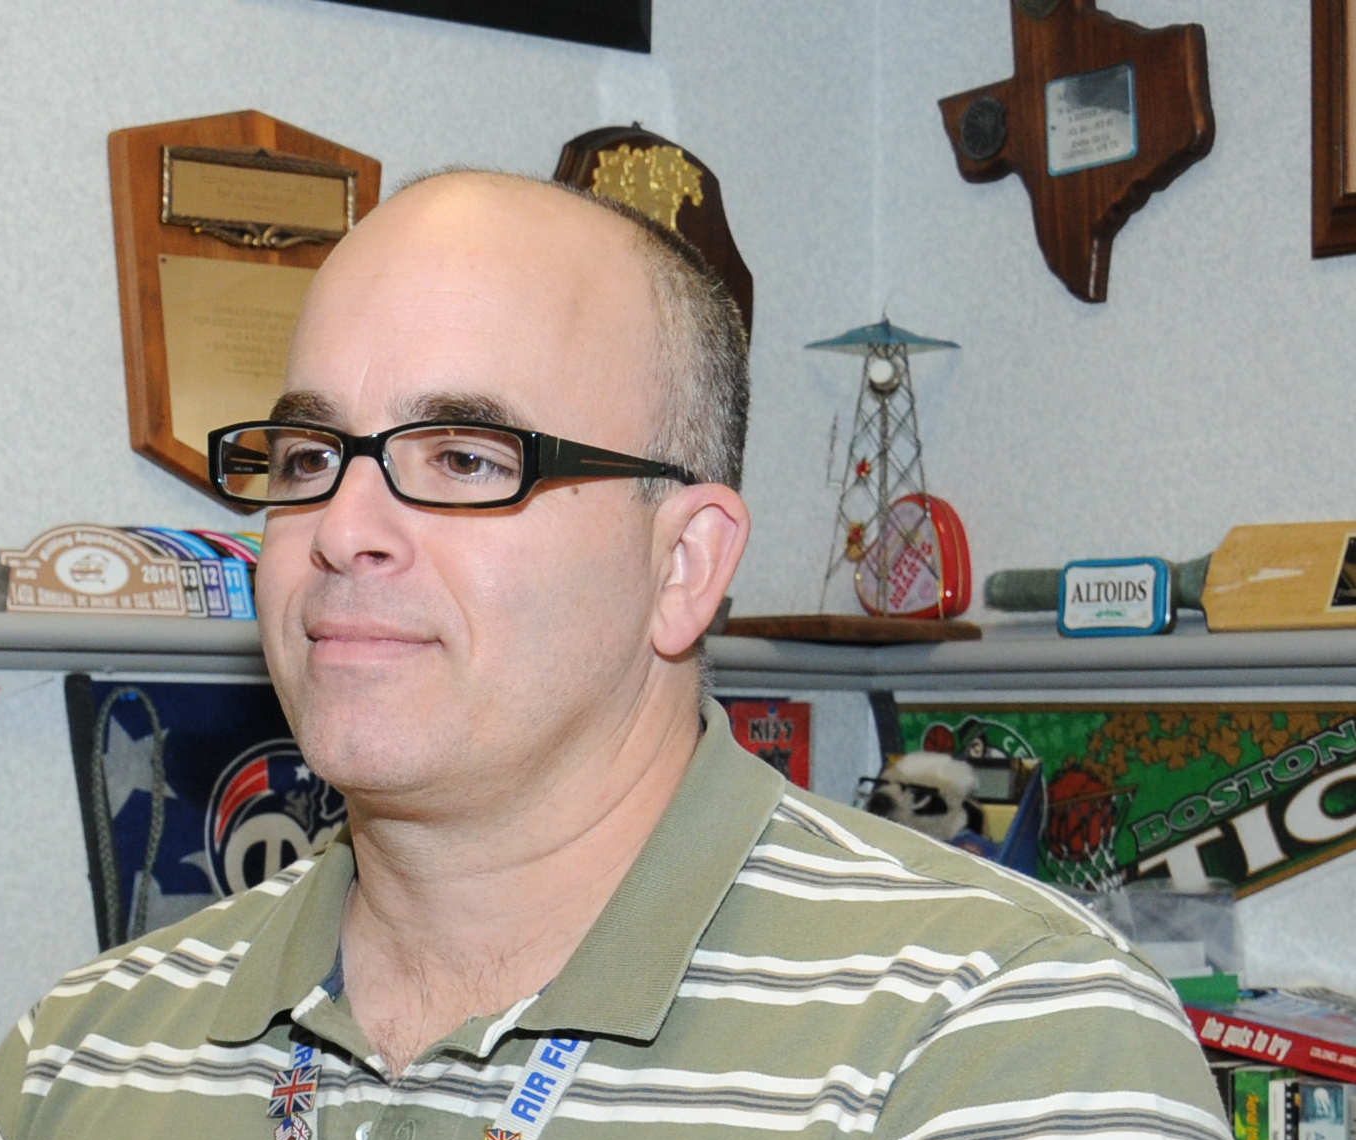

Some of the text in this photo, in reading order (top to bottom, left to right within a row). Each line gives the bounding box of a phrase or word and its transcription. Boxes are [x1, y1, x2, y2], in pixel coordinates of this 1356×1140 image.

[1071, 579, 1148, 604] ALTOIDS
[749, 718, 795, 742] KISS
[1131, 719, 1356, 852] BOSTON
[511, 1070, 558, 1123] AIR
